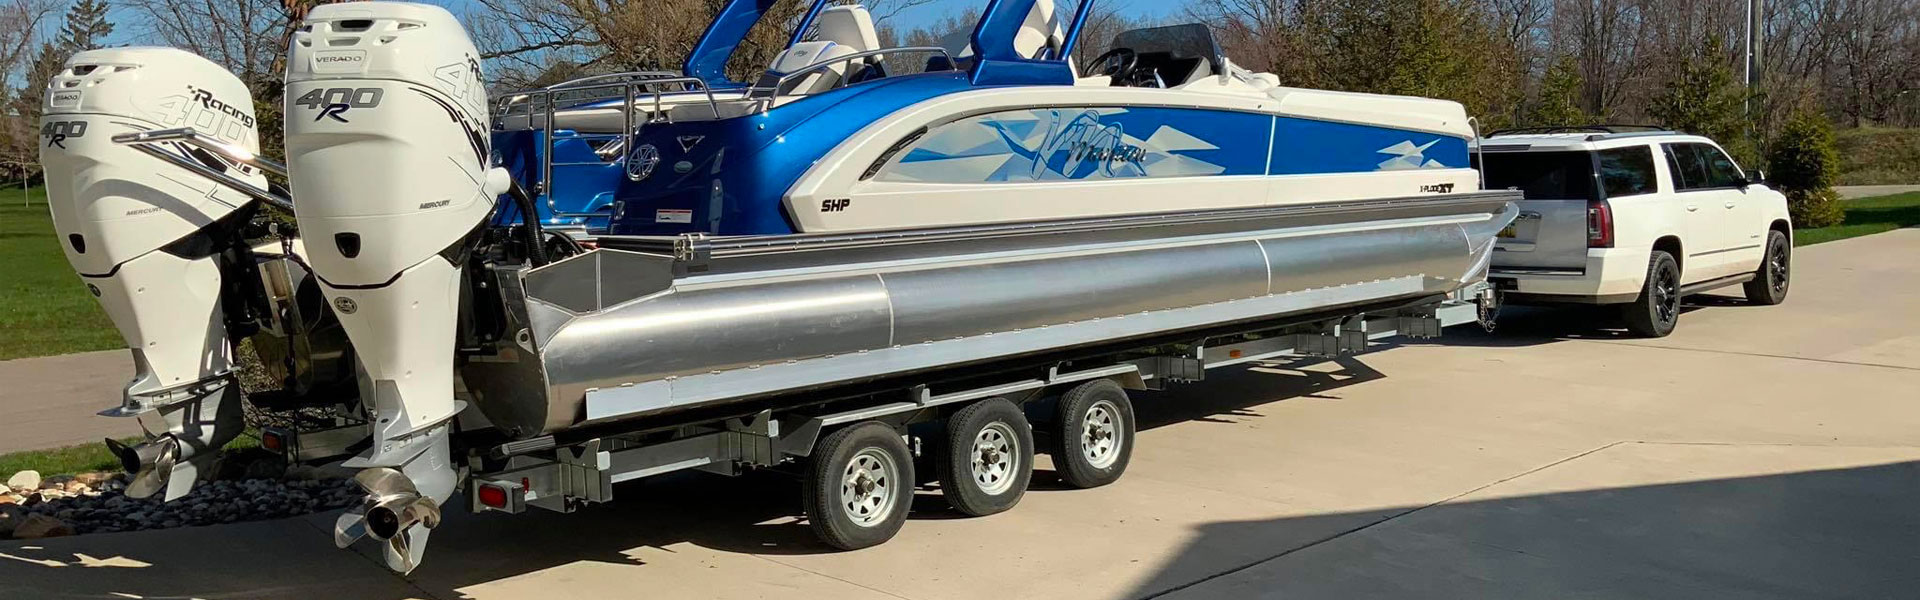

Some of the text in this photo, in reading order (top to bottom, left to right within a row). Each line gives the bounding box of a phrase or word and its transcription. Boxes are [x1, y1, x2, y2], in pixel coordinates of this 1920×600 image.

[296, 87, 384, 109] 400
[193, 88, 254, 129] Racing
[314, 103, 350, 123] R
[40, 121, 88, 138] 400
[48, 133, 66, 150] R
[820, 198, 851, 212] SHP
